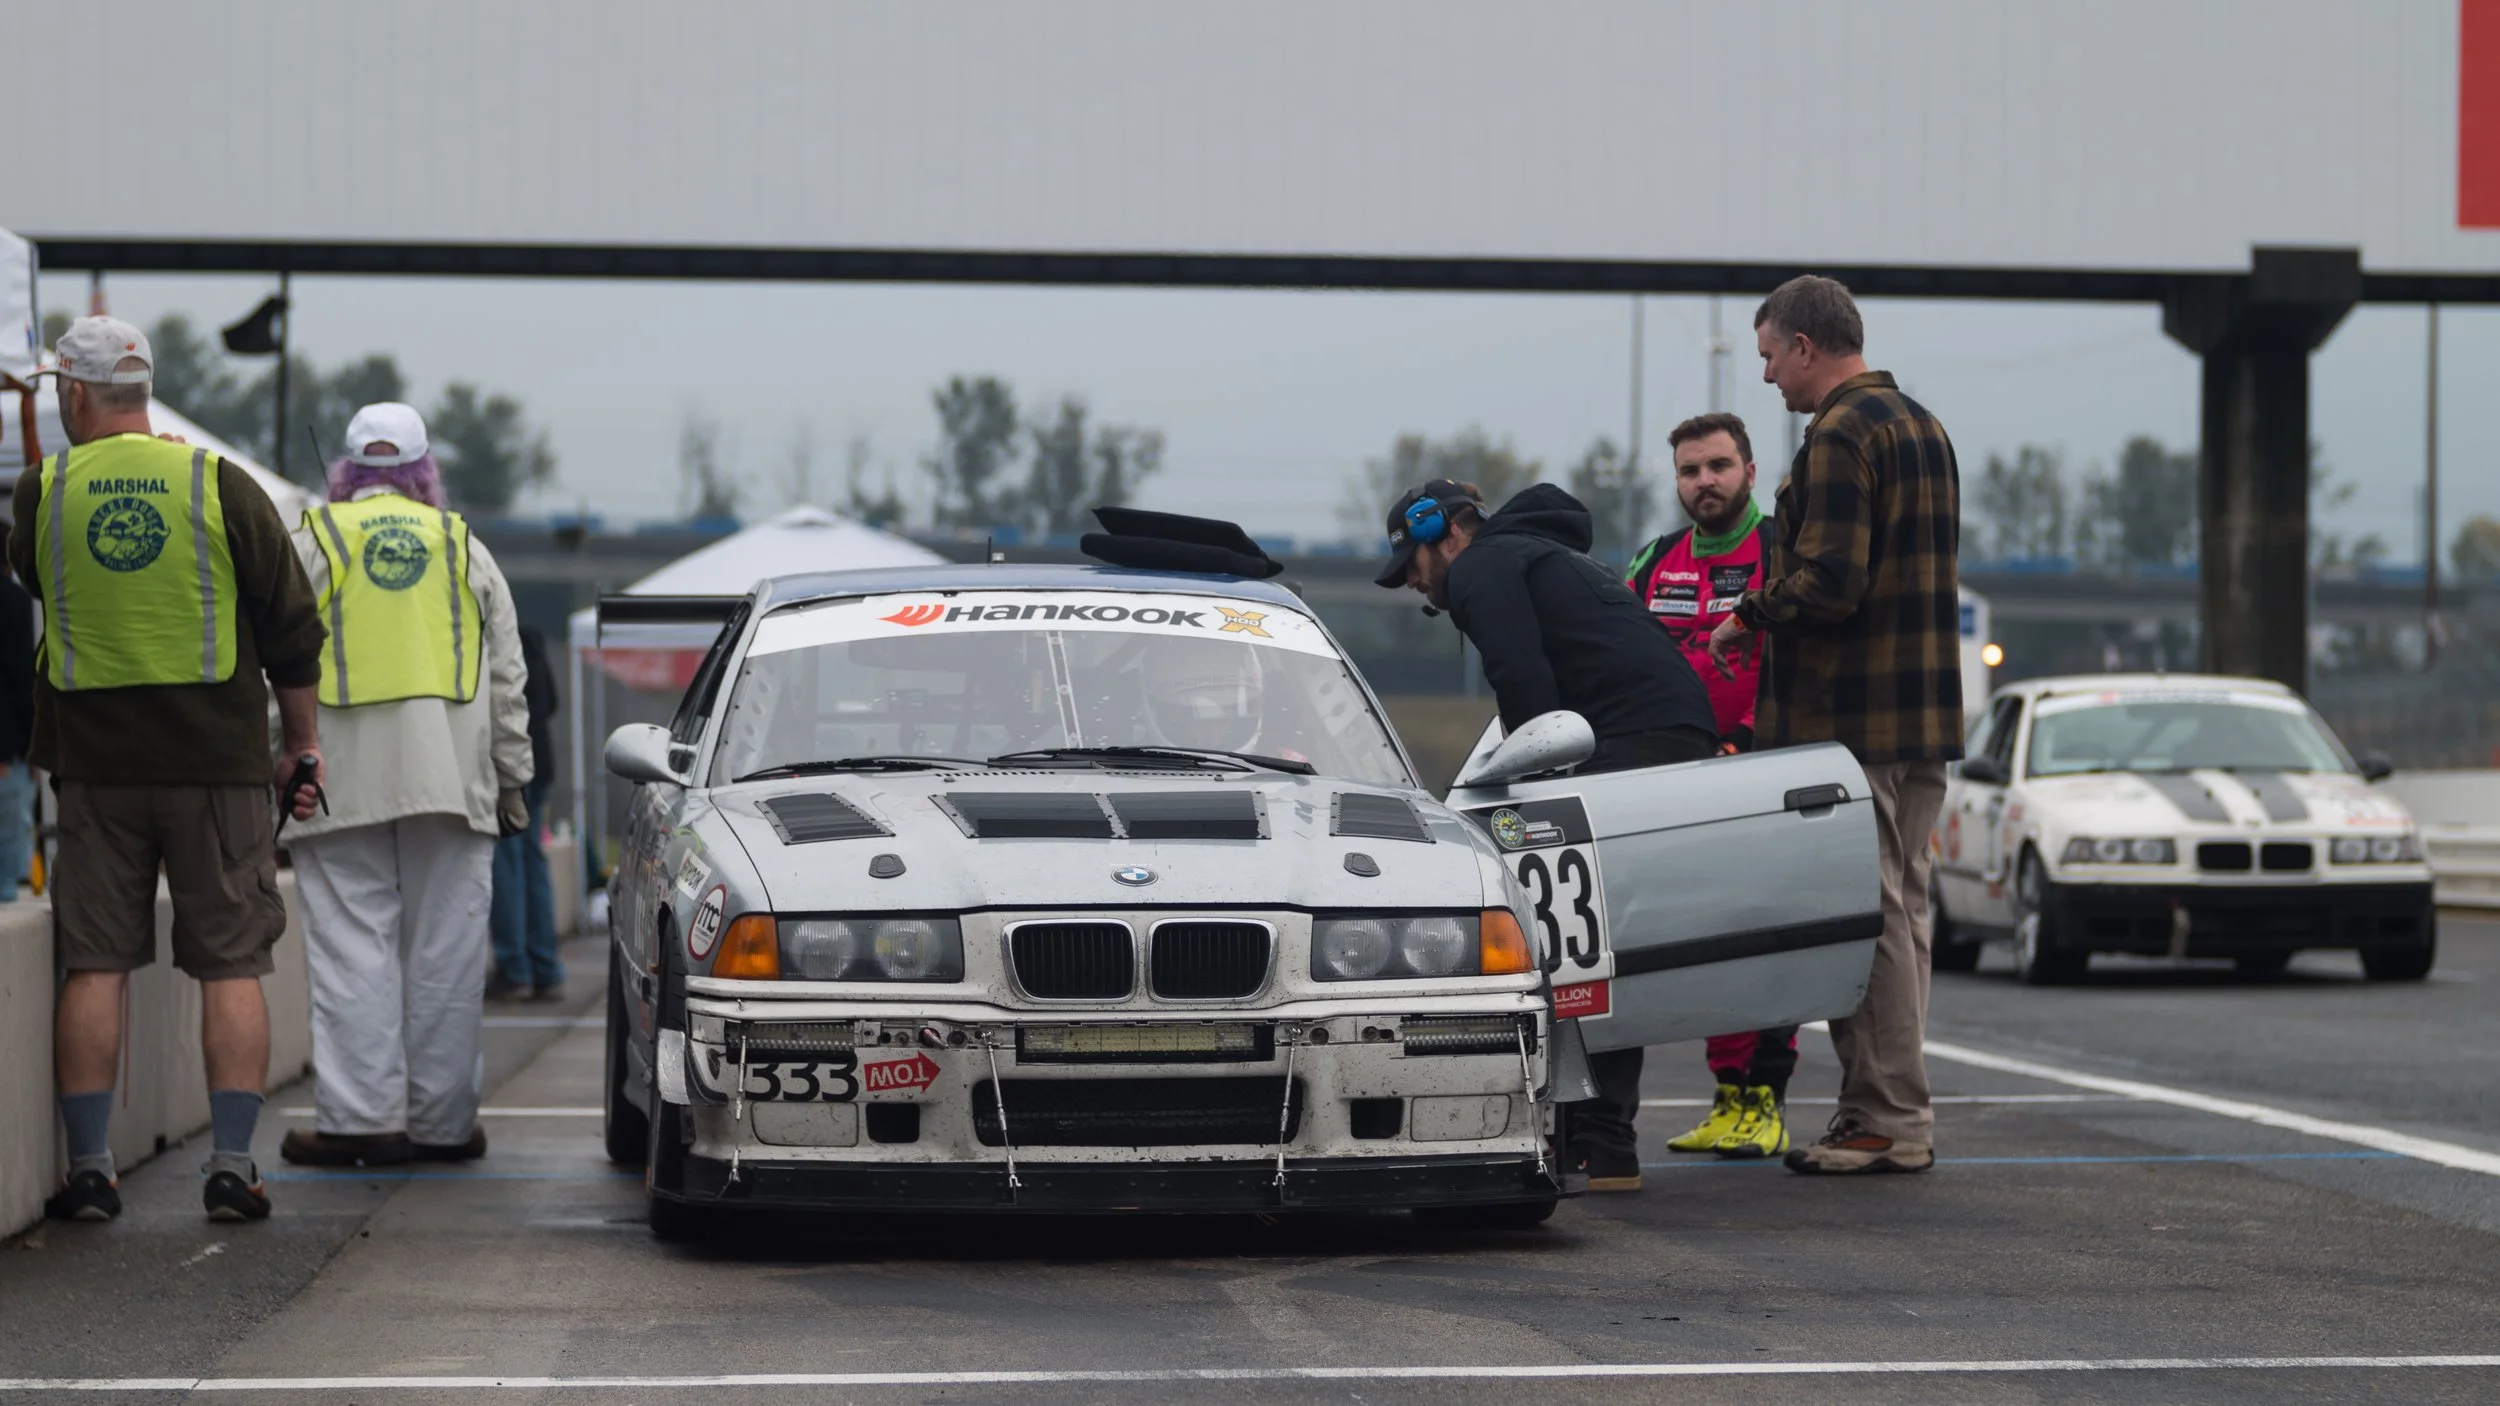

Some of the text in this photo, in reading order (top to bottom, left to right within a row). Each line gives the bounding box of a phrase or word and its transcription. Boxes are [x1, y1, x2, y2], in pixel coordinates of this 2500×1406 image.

[88, 478, 170, 496] MARSHAL
[360, 514, 425, 531] MARSHAL
[745, 1050, 859, 1100] 333
[869, 1061, 931, 1088] TOW
